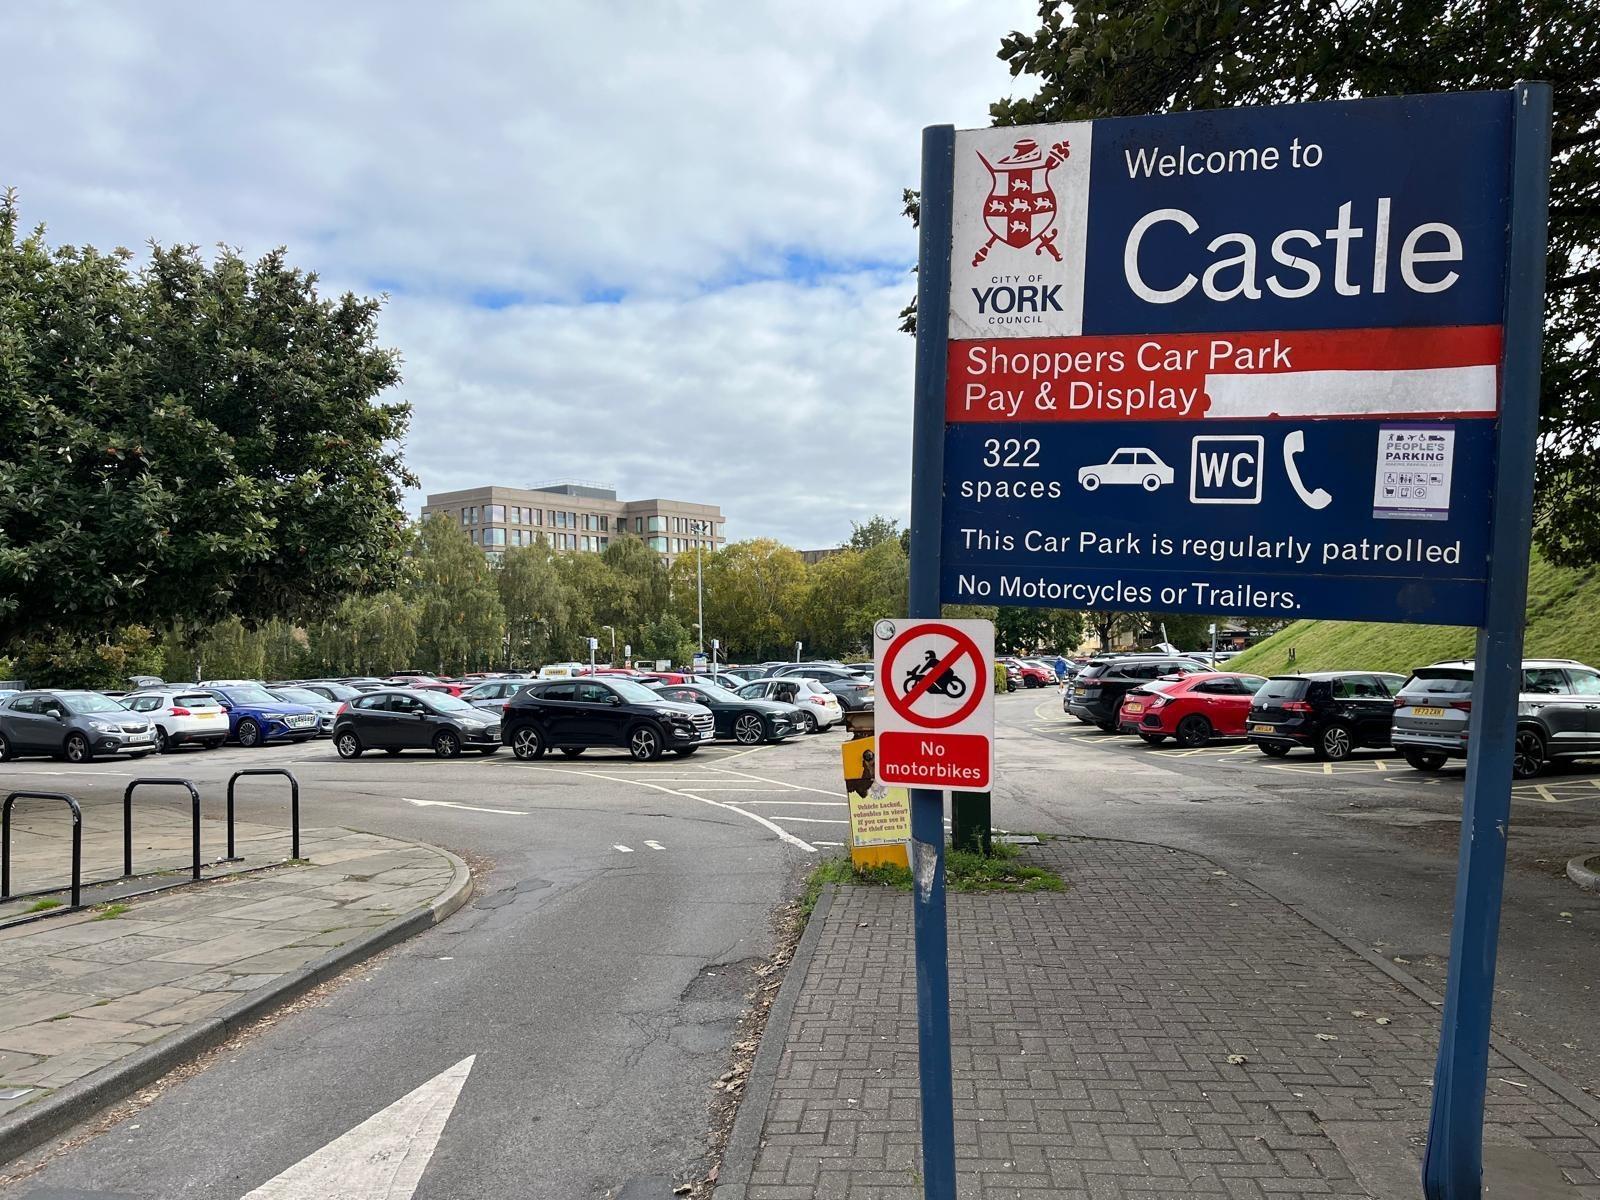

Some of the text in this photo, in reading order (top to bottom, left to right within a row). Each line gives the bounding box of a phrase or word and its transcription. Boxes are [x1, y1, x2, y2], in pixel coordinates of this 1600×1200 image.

[1124, 137, 1323, 179] Welcome to
[1123, 197, 1464, 305] Castle
[990, 274, 1043, 285] CITY OF
[971, 284, 1064, 314] YORK
[988, 315, 1042, 325] COUNCIL
[966, 338, 1293, 381] Shoppers Car Park
[965, 380, 1199, 417] Pay & Display
[983, 438, 1042, 469] 322
[1385, 452, 1445, 461] PARKING
[1386, 442, 1445, 452] PEOPLE'S
[1199, 451, 1256, 489] WC
[960, 480, 1062, 504] spaces
[960, 528, 1462, 565] This Car Park is regularly patrolled
[958, 574, 1302, 609] No Motorcycles or Trailers.
[920, 740, 946, 757] No
[885, 761, 982, 780] motorbikes
[864, 819, 876, 827] you
